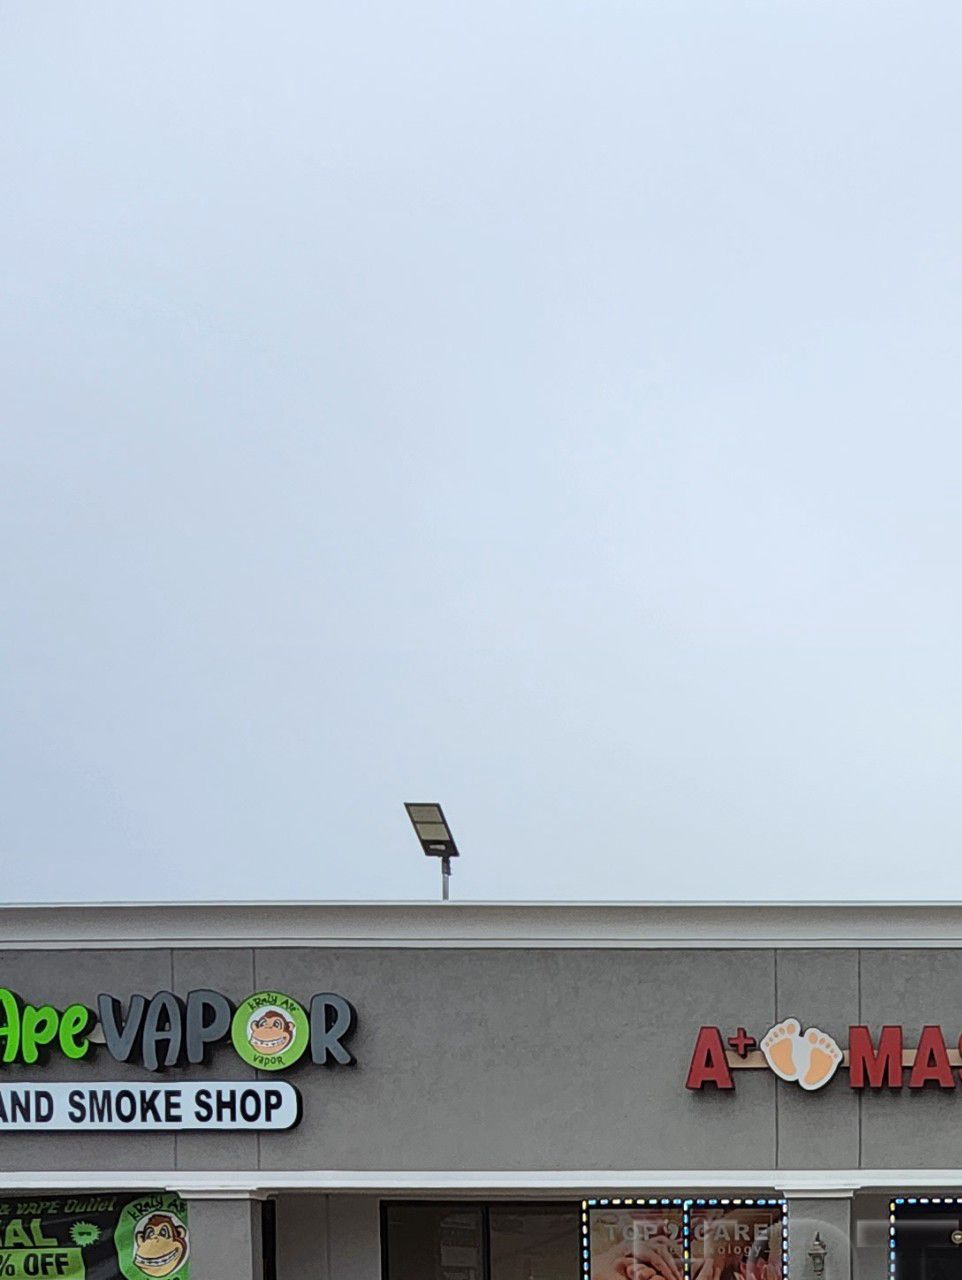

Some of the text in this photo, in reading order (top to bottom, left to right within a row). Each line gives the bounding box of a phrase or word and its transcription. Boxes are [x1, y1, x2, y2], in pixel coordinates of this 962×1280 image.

[68, 1089, 182, 1123] SMOKE
[194, 1088, 283, 1123] SHOP
[0, 1218, 59, 1248] AL
[24, 1253, 69, 1276] OFF
